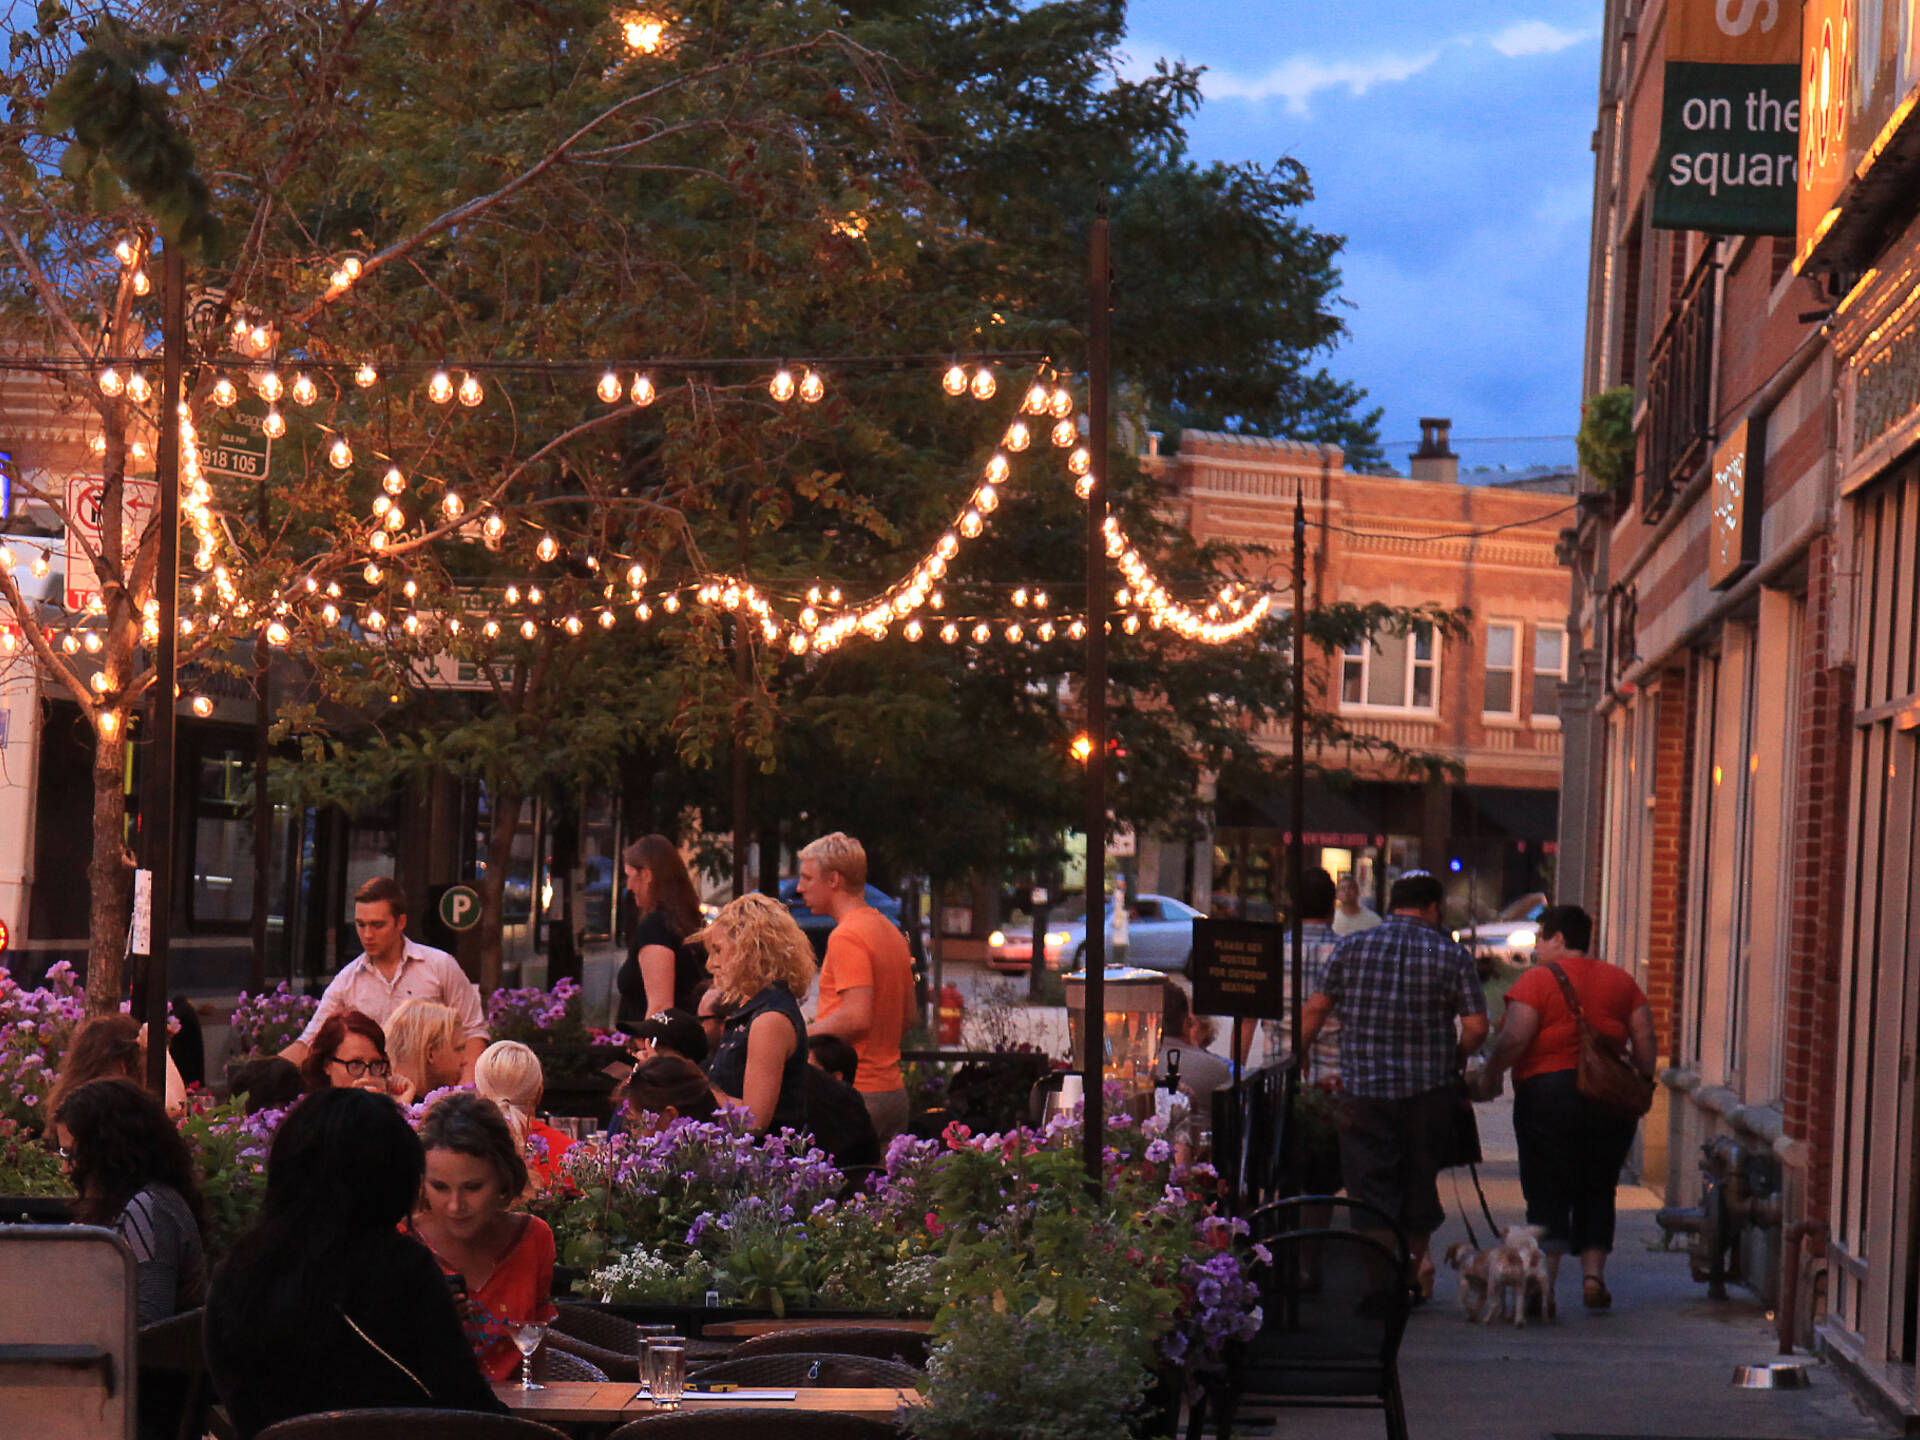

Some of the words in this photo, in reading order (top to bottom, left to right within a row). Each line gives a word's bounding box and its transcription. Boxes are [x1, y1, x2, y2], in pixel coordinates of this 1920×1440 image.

[1682, 97, 1731, 132] on
[1745, 88, 1800, 133] the
[1668, 151, 1798, 197] squar
[232, 453, 257, 474] 105
[453, 894, 471, 923] P
